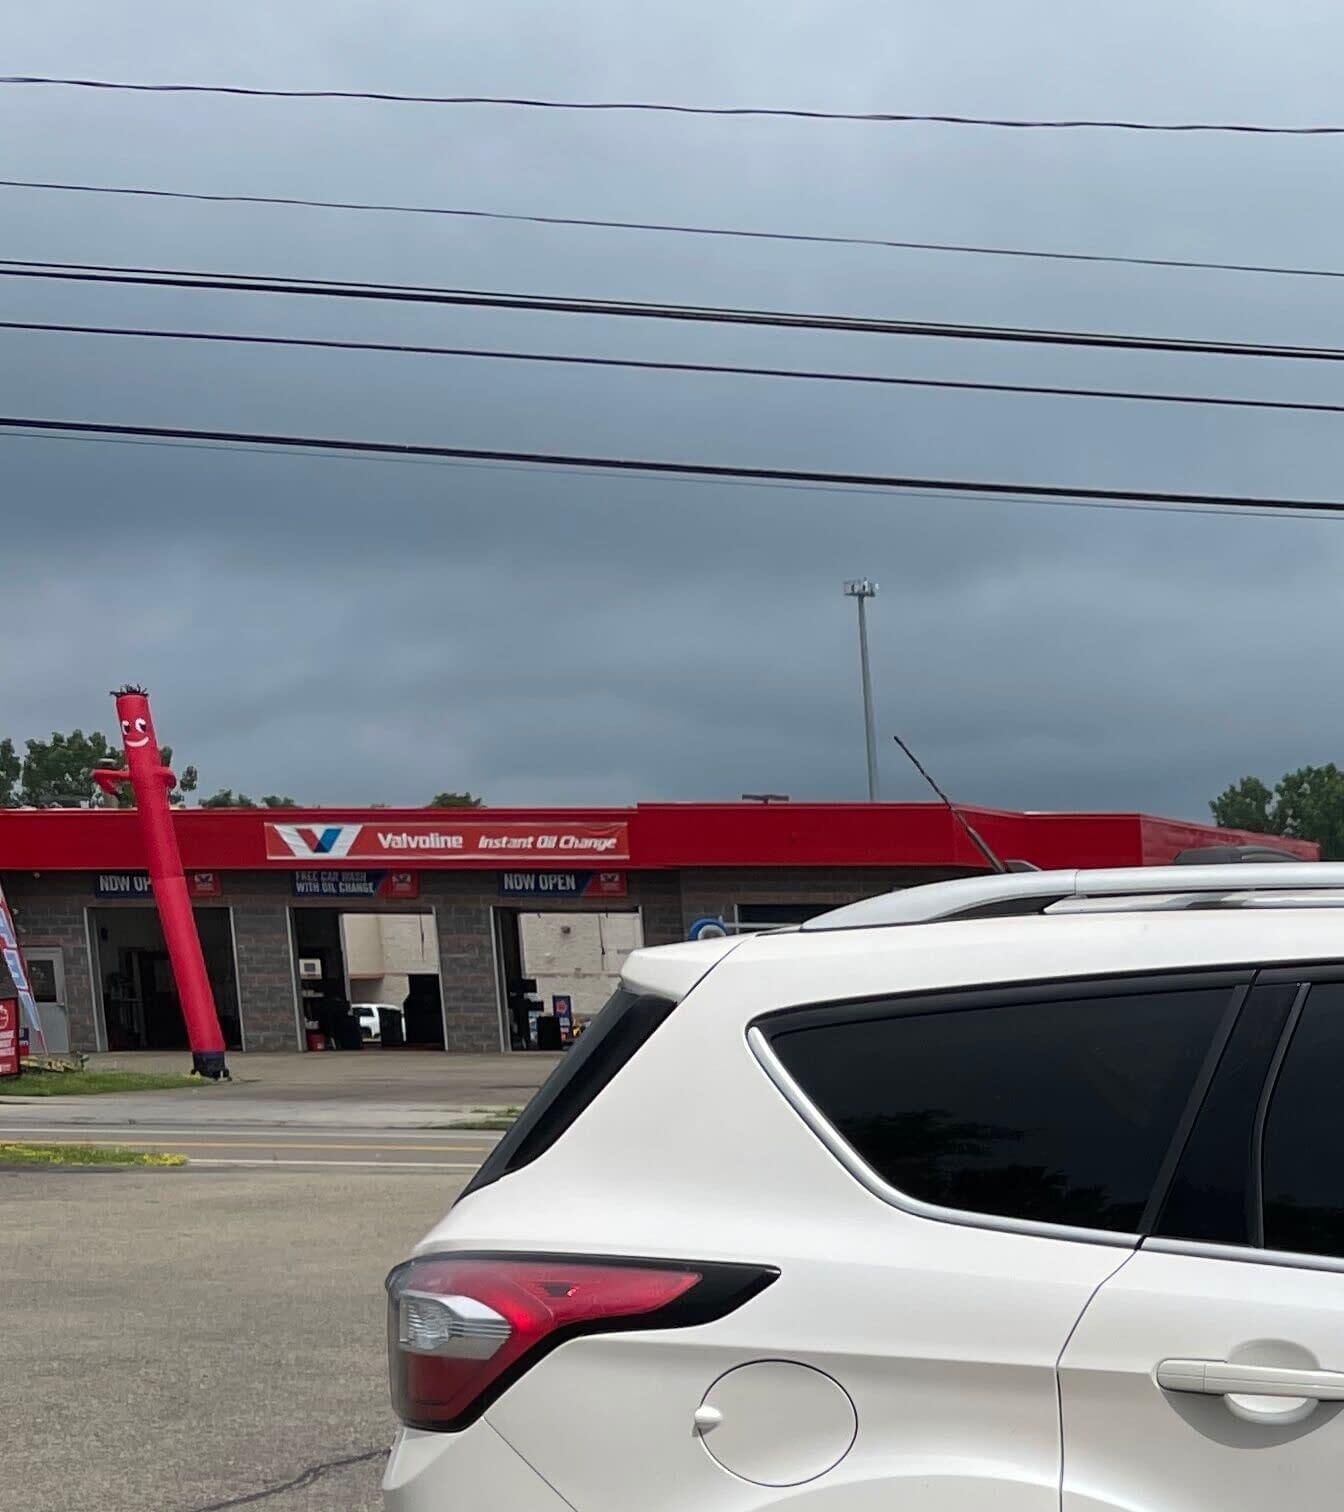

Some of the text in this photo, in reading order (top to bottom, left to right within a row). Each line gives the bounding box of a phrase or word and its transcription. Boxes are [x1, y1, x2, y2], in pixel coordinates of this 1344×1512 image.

[377, 832, 617, 851] Valvoline Instant Oil Change
[504, 873, 576, 890] NOW OPEN
